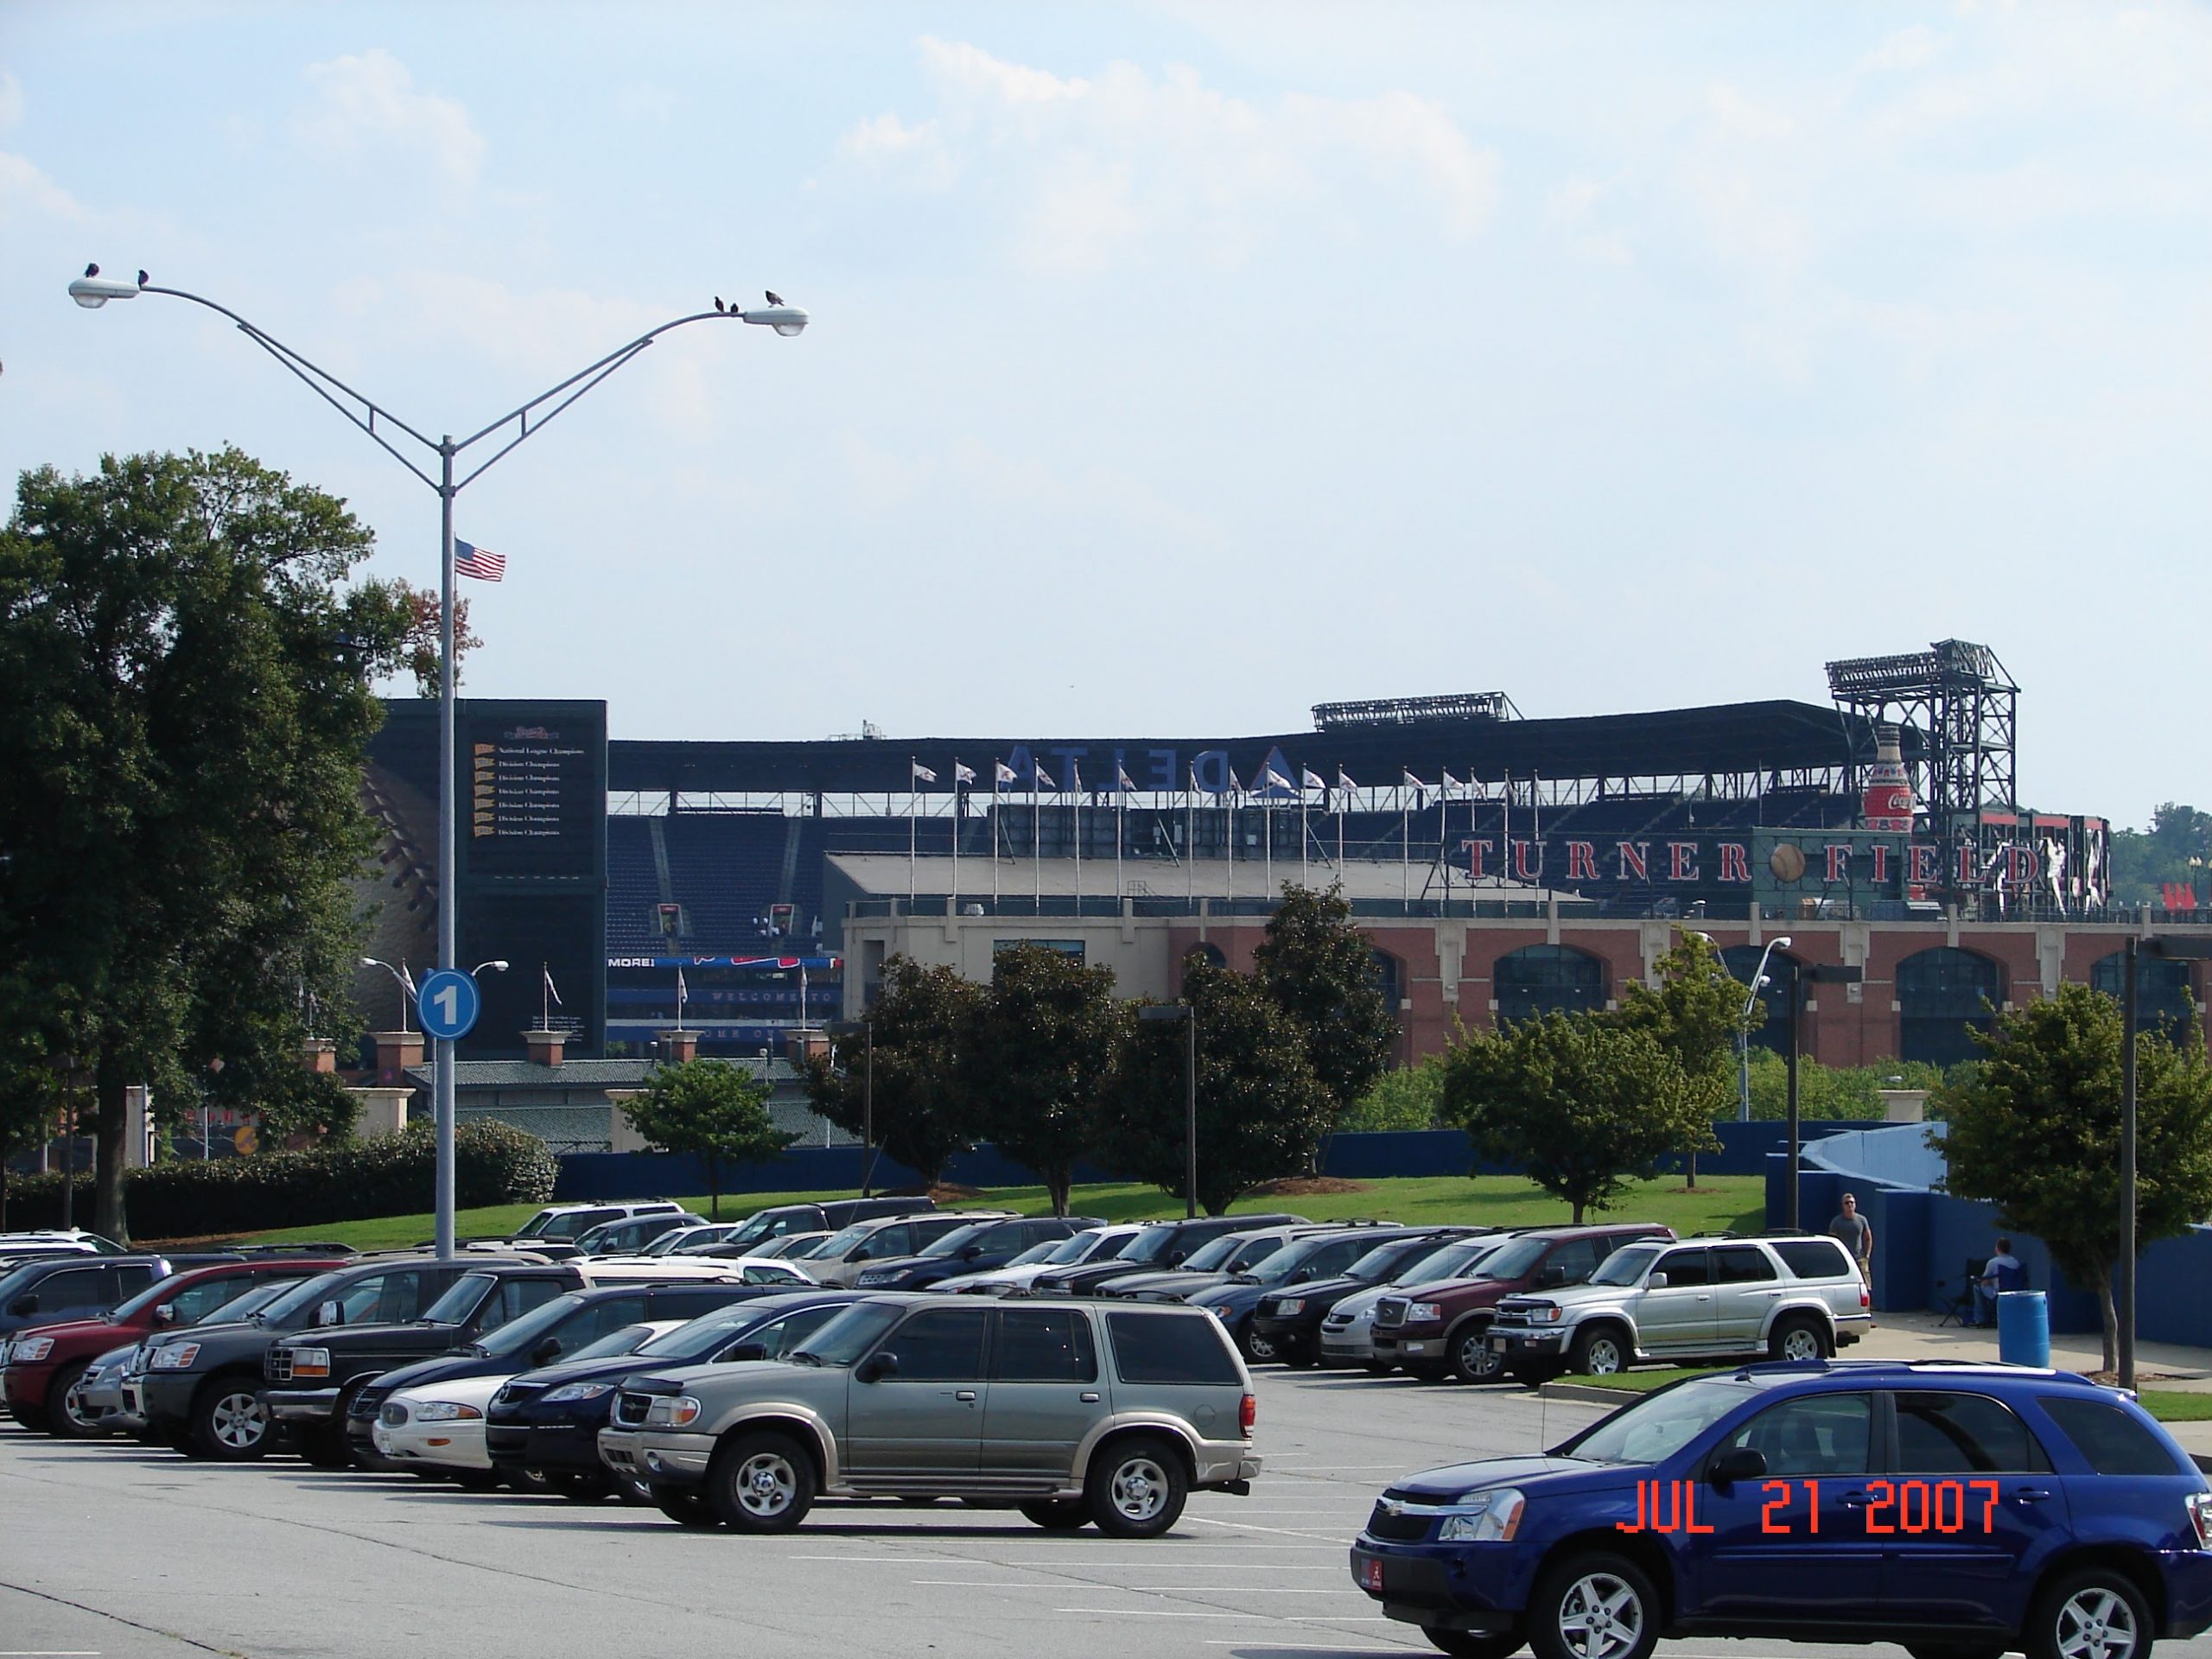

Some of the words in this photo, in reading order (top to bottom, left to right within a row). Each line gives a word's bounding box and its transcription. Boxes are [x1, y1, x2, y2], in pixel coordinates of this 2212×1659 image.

[1461, 839, 1751, 882] TURNER
[1823, 844, 2038, 884] FIELD
[434, 985, 457, 1025] 1
[713, 993, 798, 1001] WELCOME
[810, 993, 831, 1001] TO
